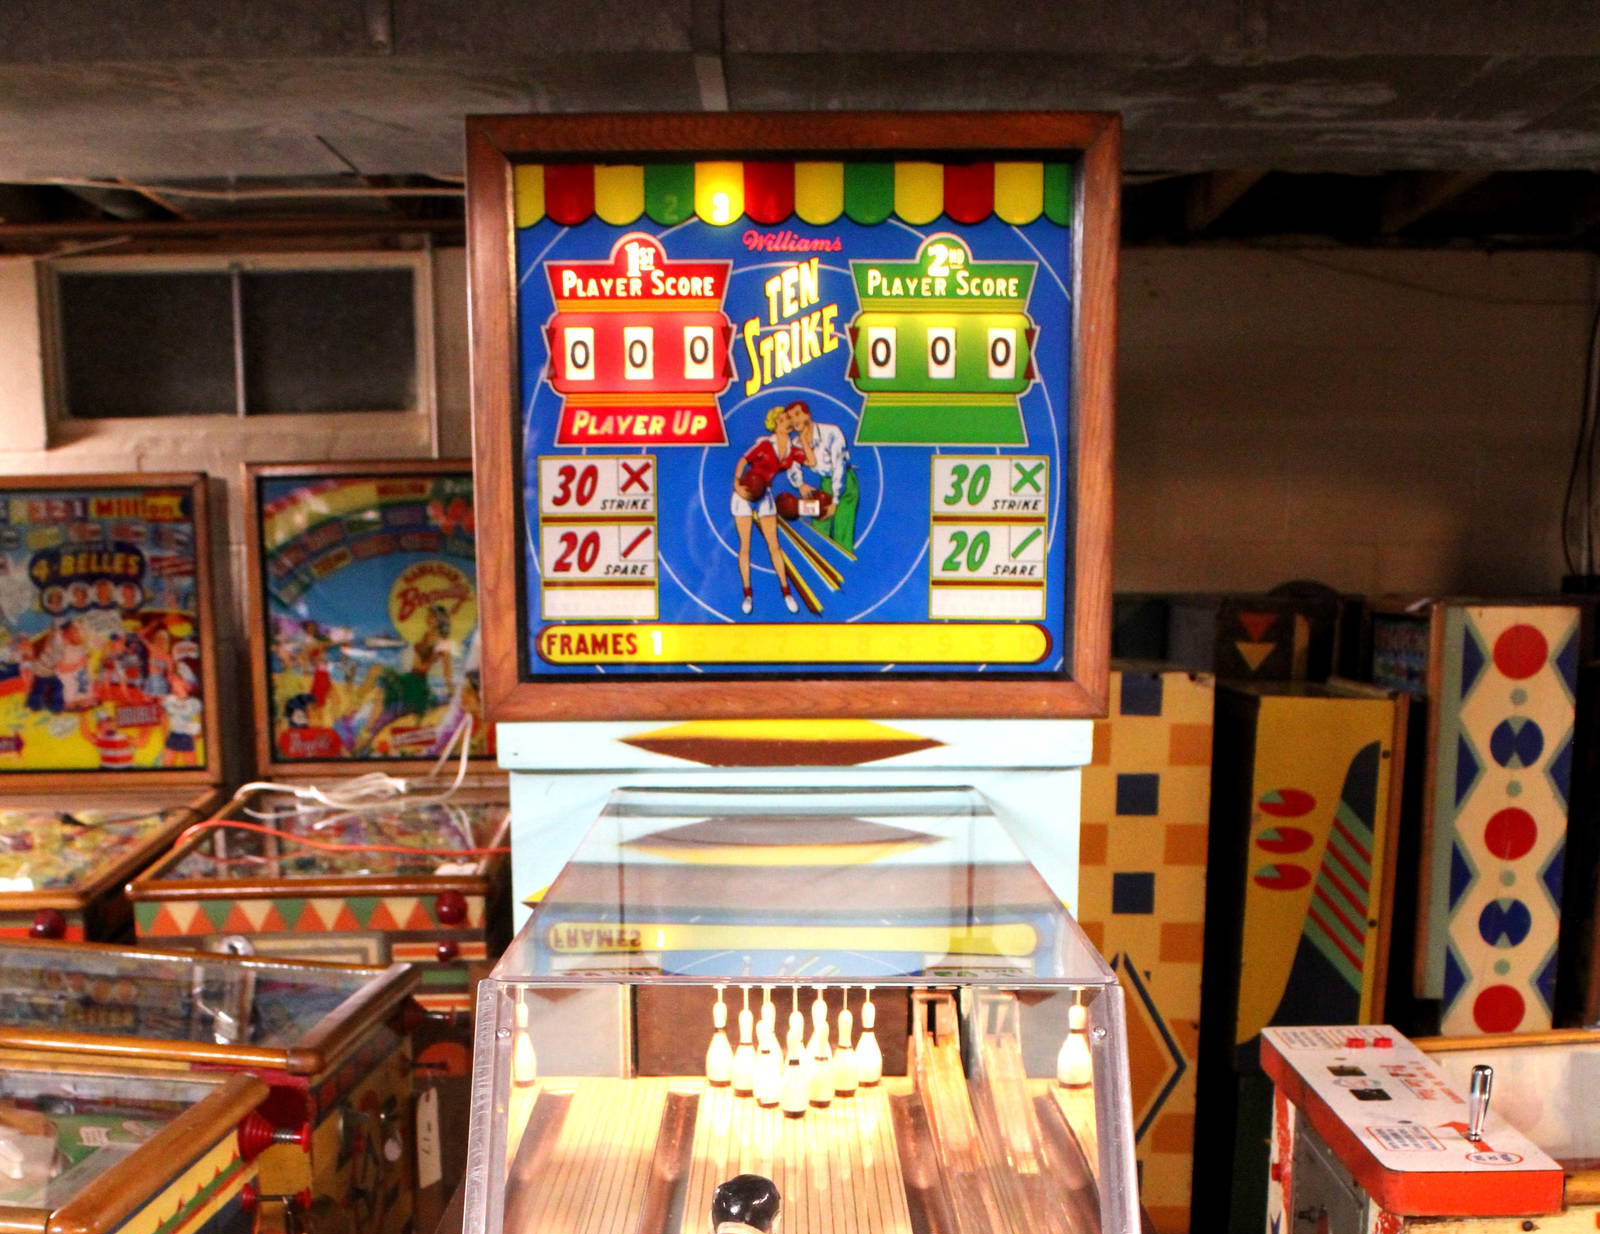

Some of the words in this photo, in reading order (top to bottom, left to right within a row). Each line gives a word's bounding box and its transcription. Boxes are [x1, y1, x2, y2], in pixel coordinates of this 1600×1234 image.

[742, 229, 842, 252] Williams
[562, 269, 643, 297] PLAYER
[651, 269, 715, 296] SCORE
[765, 257, 820, 325] TEN
[867, 268, 947, 296] PLAYER
[956, 269, 1019, 297] SCORE
[571, 340, 589, 368] 0
[629, 340, 647, 368] 0
[690, 336, 708, 364] 0
[743, 303, 838, 397] STRIKE
[871, 337, 891, 367] 0
[931, 336, 950, 365] 0
[991, 337, 1011, 367] 0
[571, 410, 666, 436] PLAYER
[672, 410, 708, 436] UP
[552, 464, 598, 506] 30
[944, 464, 991, 506] 30
[600, 499, 649, 511] STRIKE
[992, 499, 1041, 511] STRIKE
[553, 531, 600, 572] 20
[942, 530, 990, 571] 20
[604, 565, 648, 575] SPARE
[993, 565, 1037, 576] SPARE
[546, 633, 638, 655] FRAMES
[651, 630, 663, 656] 1
